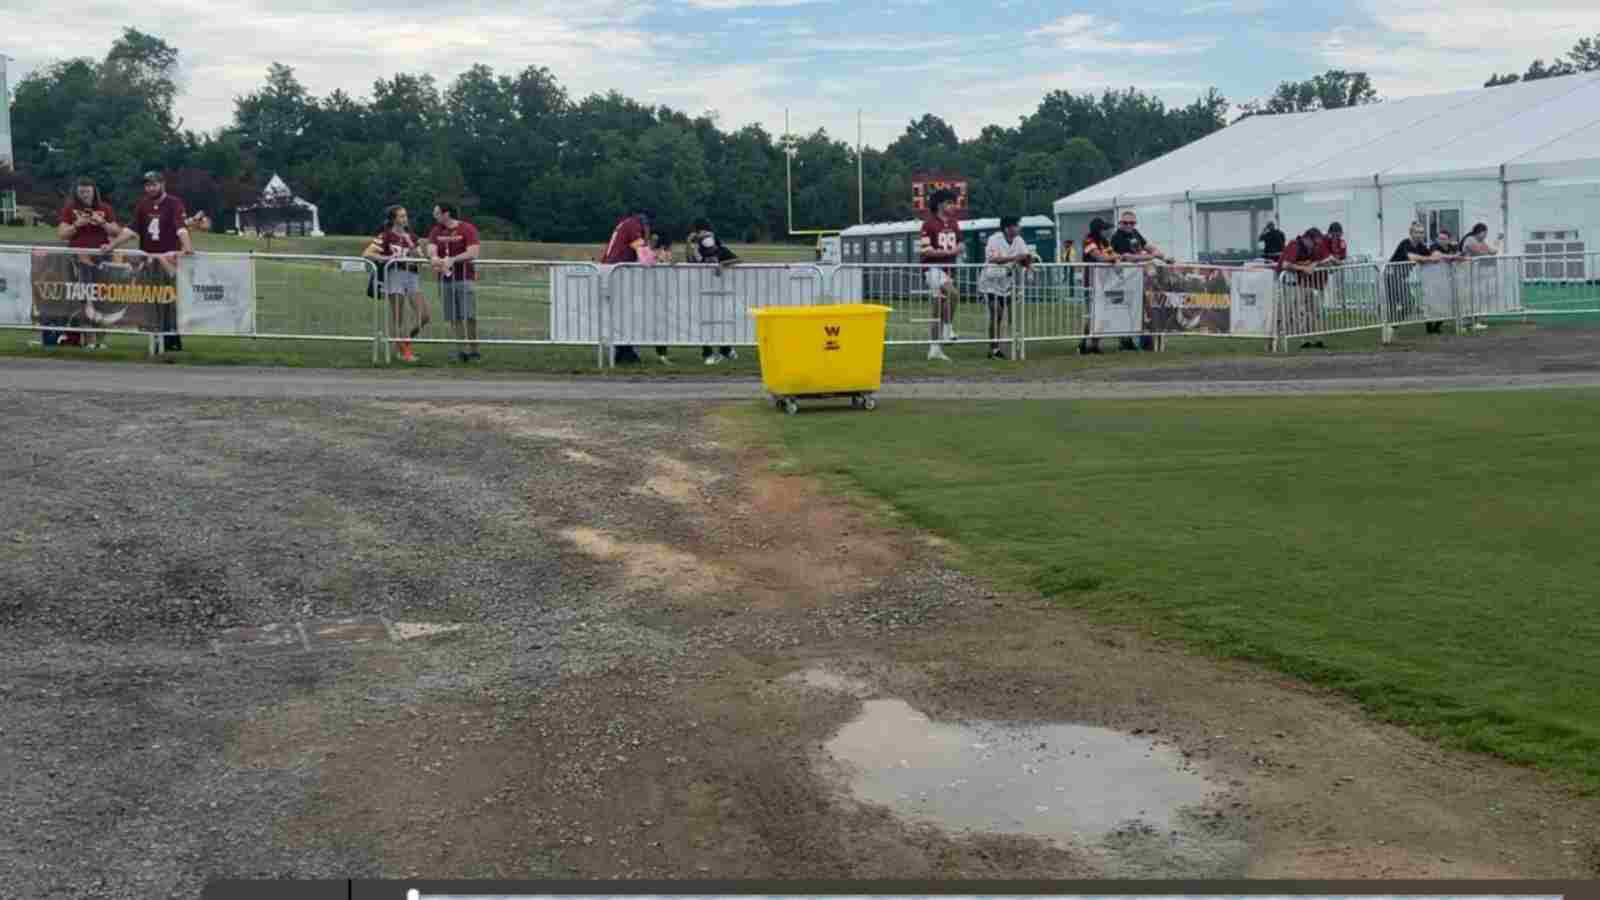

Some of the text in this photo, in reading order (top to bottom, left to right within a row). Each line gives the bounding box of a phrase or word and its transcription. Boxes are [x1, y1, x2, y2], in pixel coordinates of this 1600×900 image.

[148, 217, 160, 240] 4
[938, 231, 957, 250] 99
[824, 326, 840, 337] W
